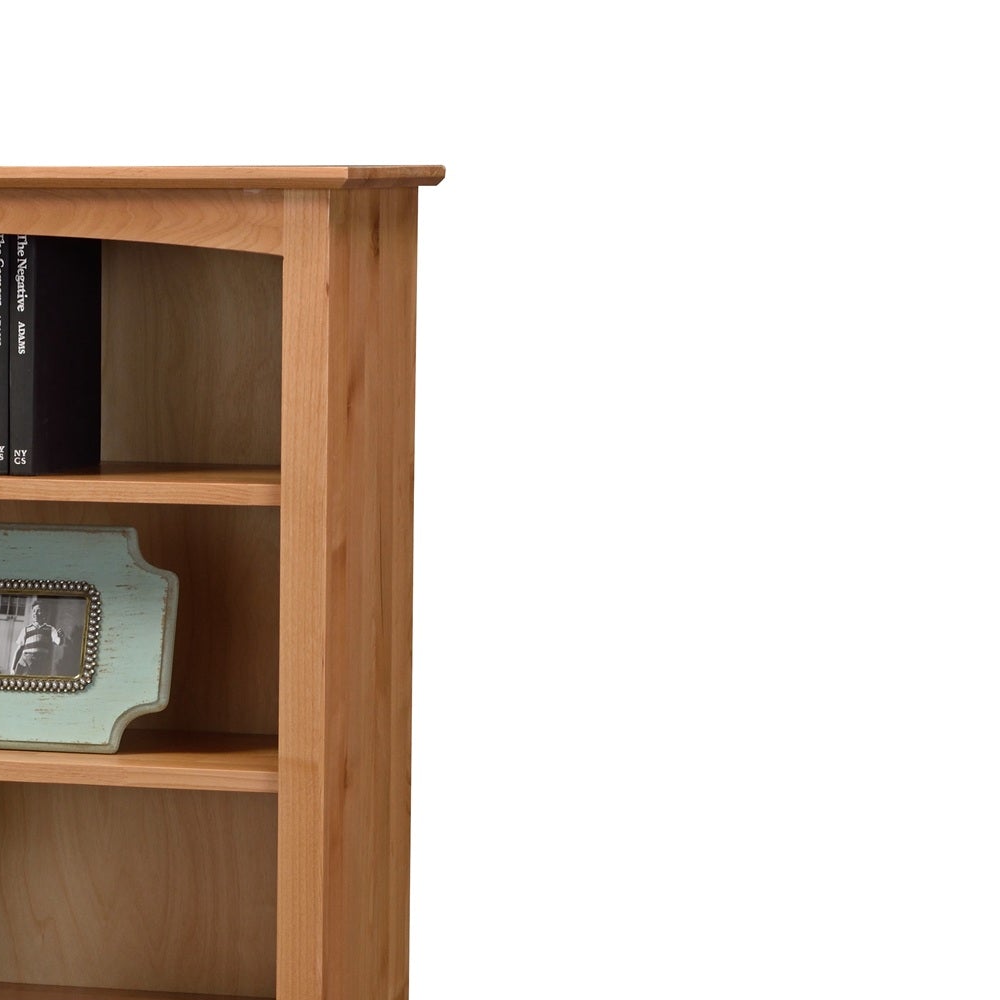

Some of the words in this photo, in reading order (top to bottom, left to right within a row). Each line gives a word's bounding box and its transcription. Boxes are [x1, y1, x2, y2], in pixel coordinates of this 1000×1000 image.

[17, 235, 28, 257] The
[15, 258, 28, 313] Negative
[18, 321, 26, 355] ADAMS
[13, 449, 28, 457] NY
